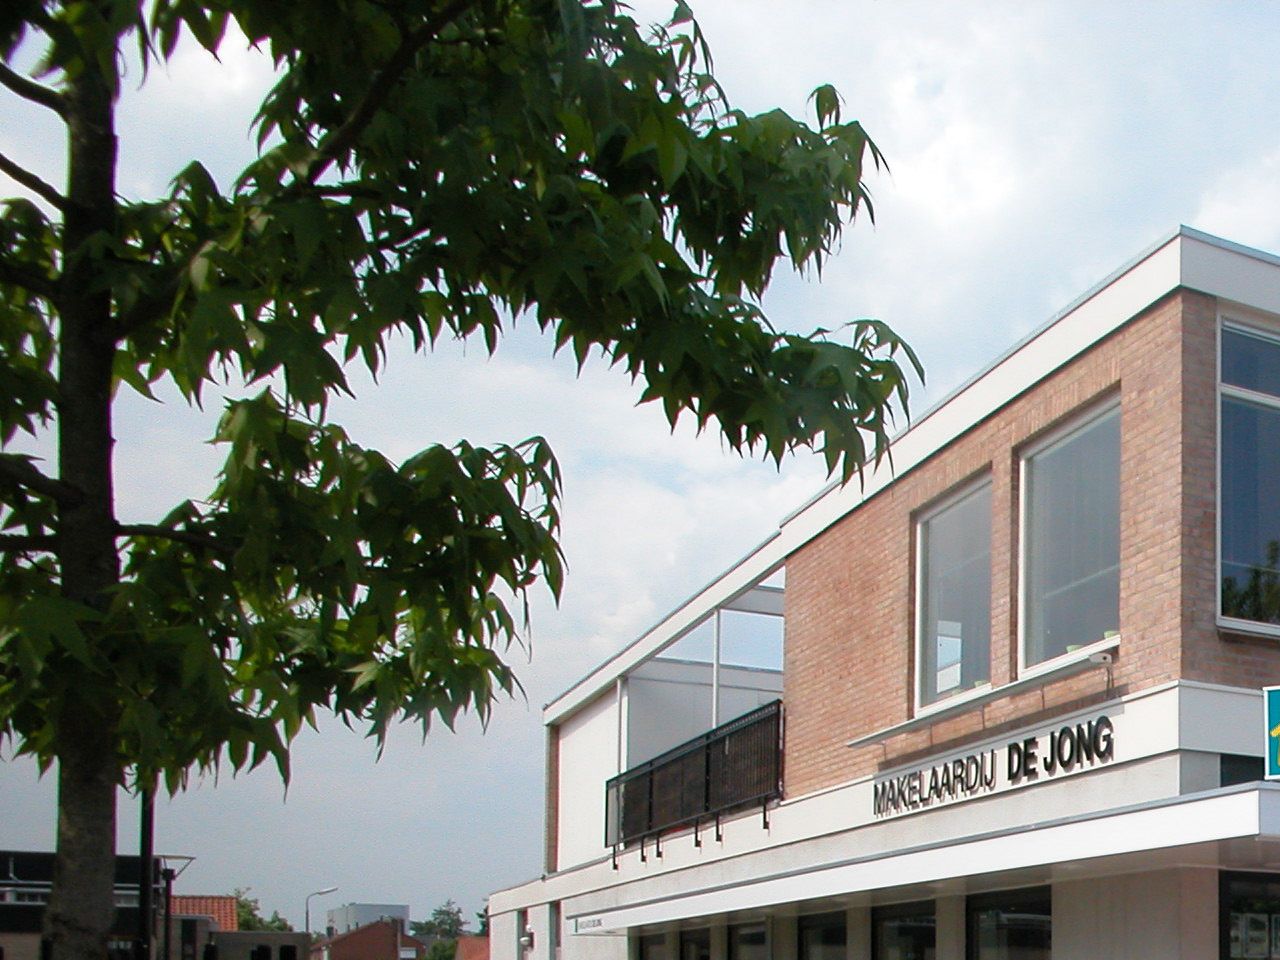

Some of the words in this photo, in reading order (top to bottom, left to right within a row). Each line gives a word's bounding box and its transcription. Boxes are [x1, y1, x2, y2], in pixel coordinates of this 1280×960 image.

[873, 748, 996, 816] MAKELAARDIJ
[1007, 736, 1037, 782] DE
[1043, 715, 1115, 771] JONG
